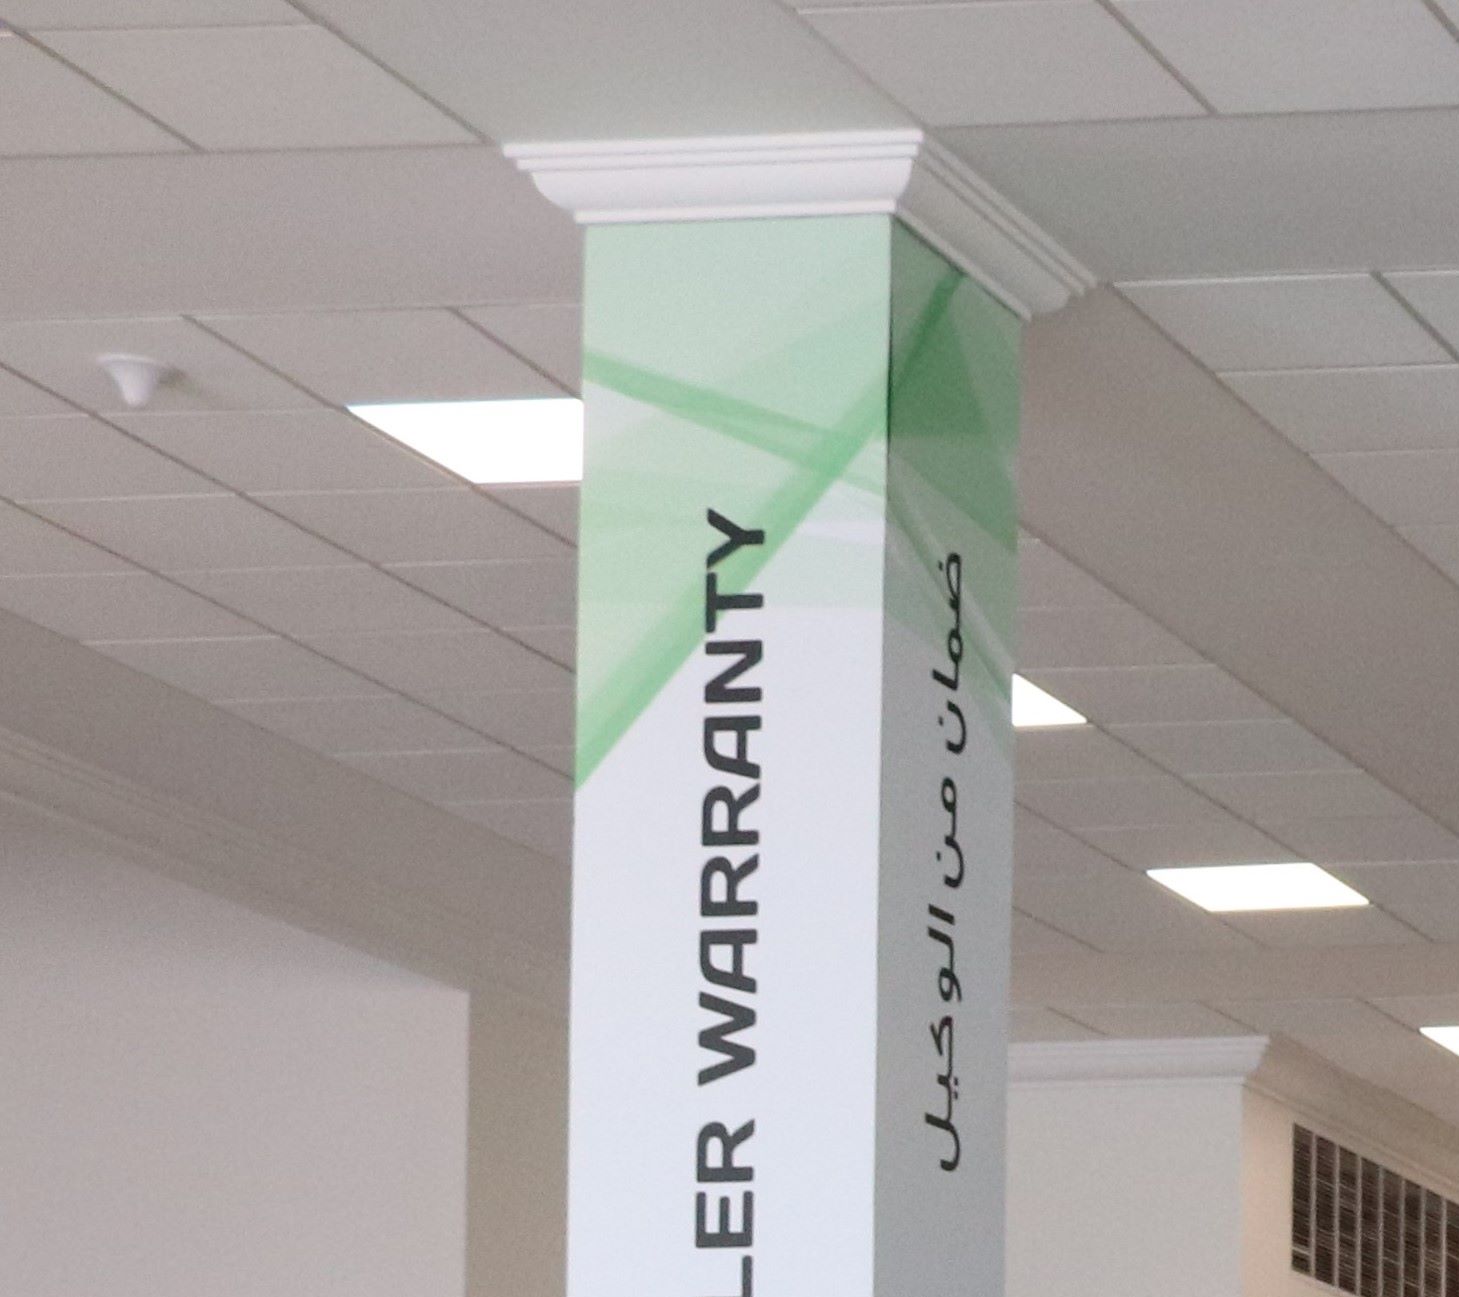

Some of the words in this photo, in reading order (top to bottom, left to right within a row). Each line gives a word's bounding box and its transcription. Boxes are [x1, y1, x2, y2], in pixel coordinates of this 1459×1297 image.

[930, 550, 968, 756] ضمان
[696, 507, 768, 1087] WARRANTY
[934, 775, 966, 891] من
[923, 902, 964, 1174] الوكيل
